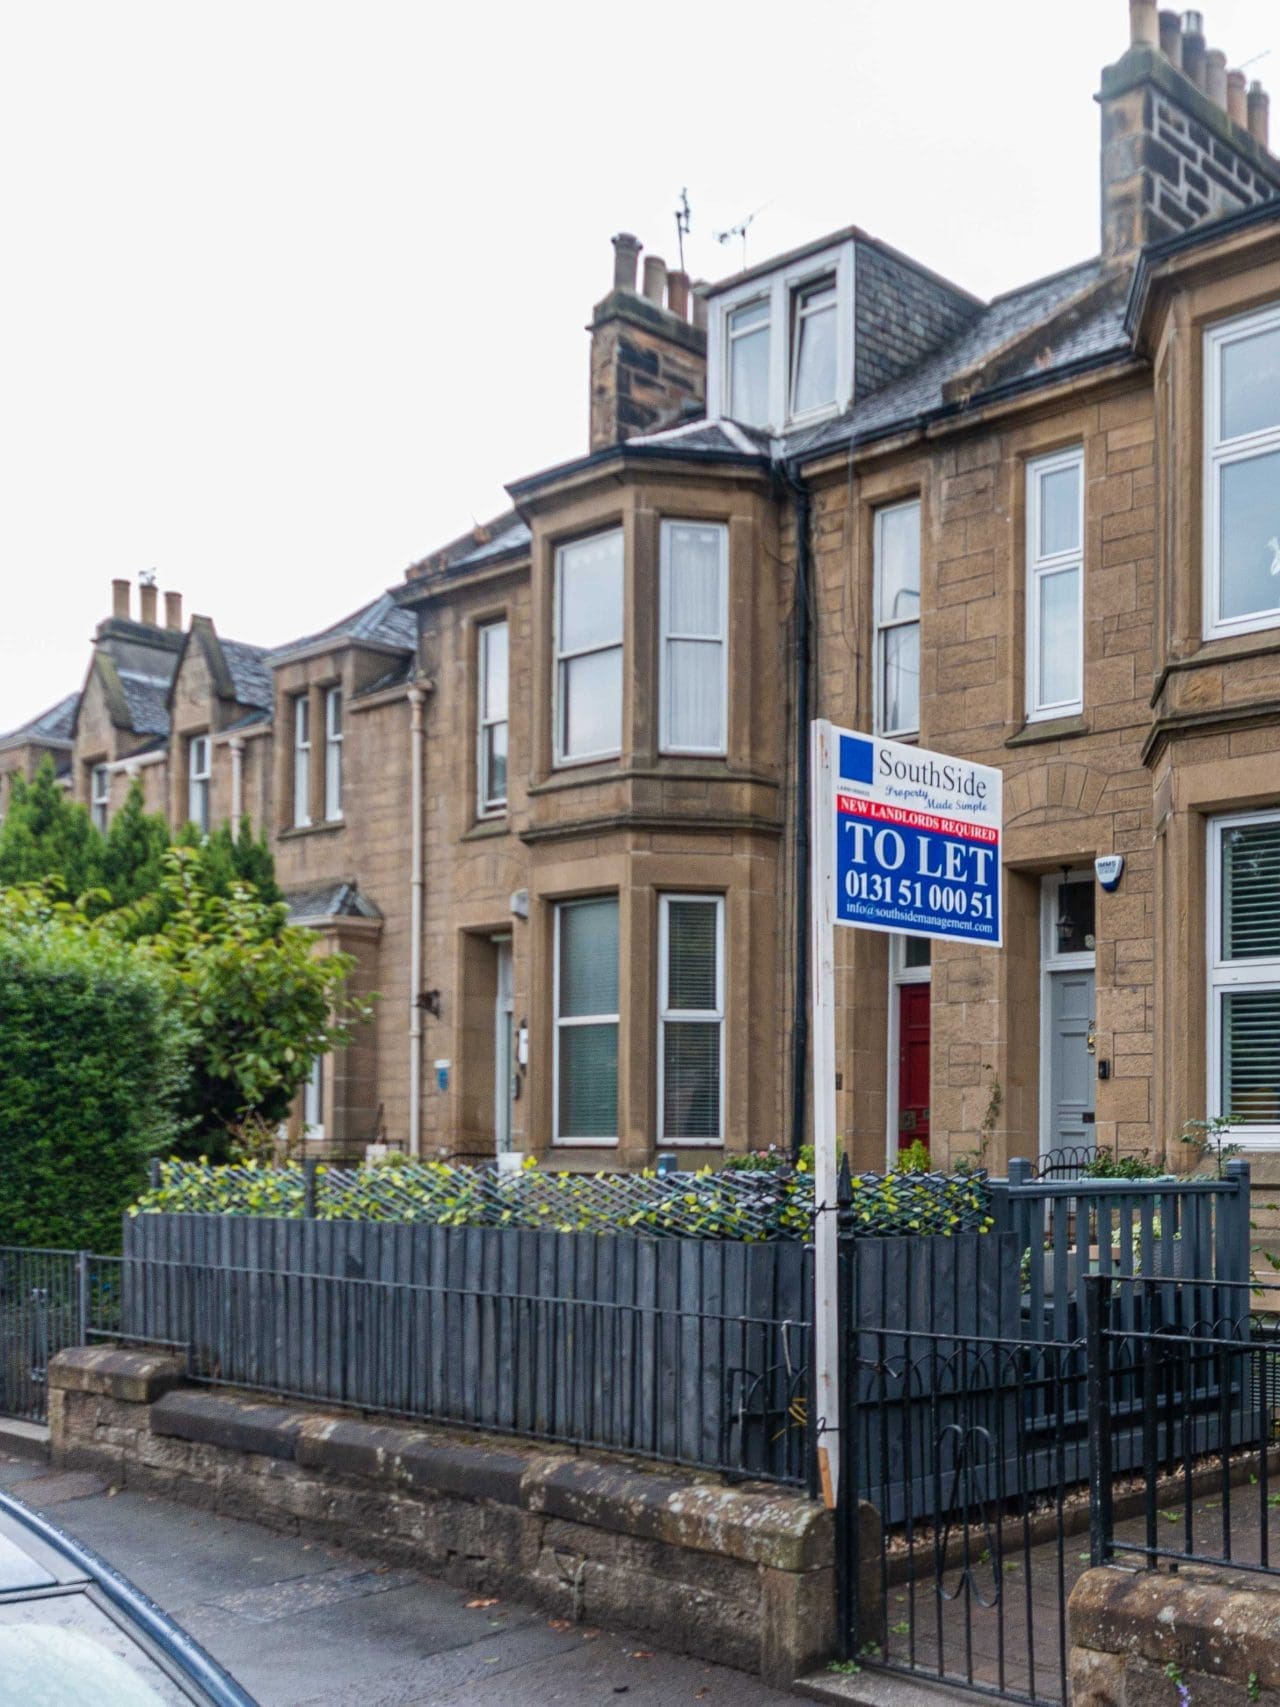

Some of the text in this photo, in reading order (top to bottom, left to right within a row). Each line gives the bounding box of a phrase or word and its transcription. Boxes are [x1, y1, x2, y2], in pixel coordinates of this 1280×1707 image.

[879, 749, 987, 798] SouthSide
[885, 785, 928, 800] Property
[841, 797, 996, 841] NEW LANDLORDS REQUIRED
[924, 799, 987, 815] Made Simple
[845, 821, 993, 886] TO LET
[845, 869, 993, 919] 0131 51 000 51
[846, 900, 993, 933] info@southsidemanagement.com
